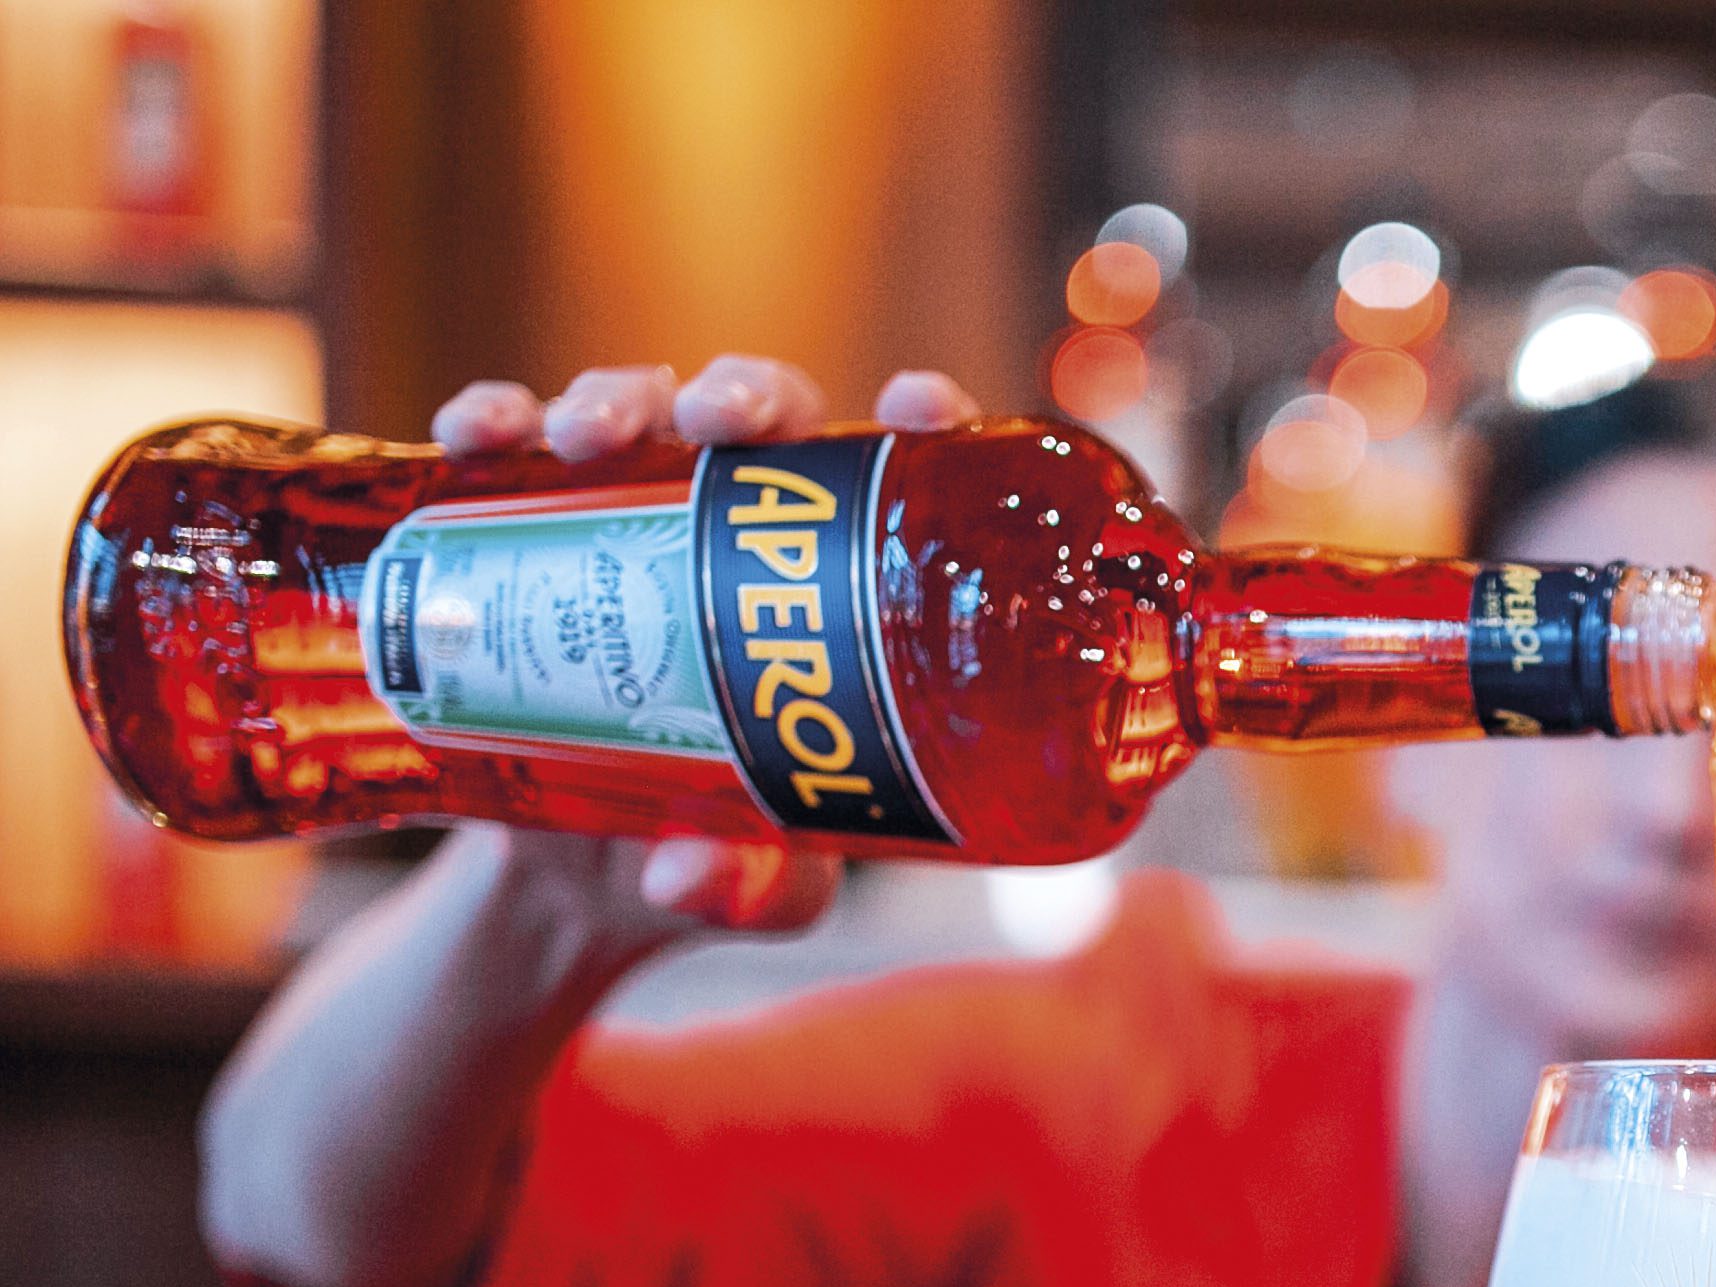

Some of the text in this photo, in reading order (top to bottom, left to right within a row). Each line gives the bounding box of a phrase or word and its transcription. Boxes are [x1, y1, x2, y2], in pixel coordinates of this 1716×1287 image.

[553, 597, 587, 665] 1919
[593, 551, 645, 709] APERITIVO
[727, 464, 874, 811] APEROL
[1501, 563, 1544, 673] APEROL
